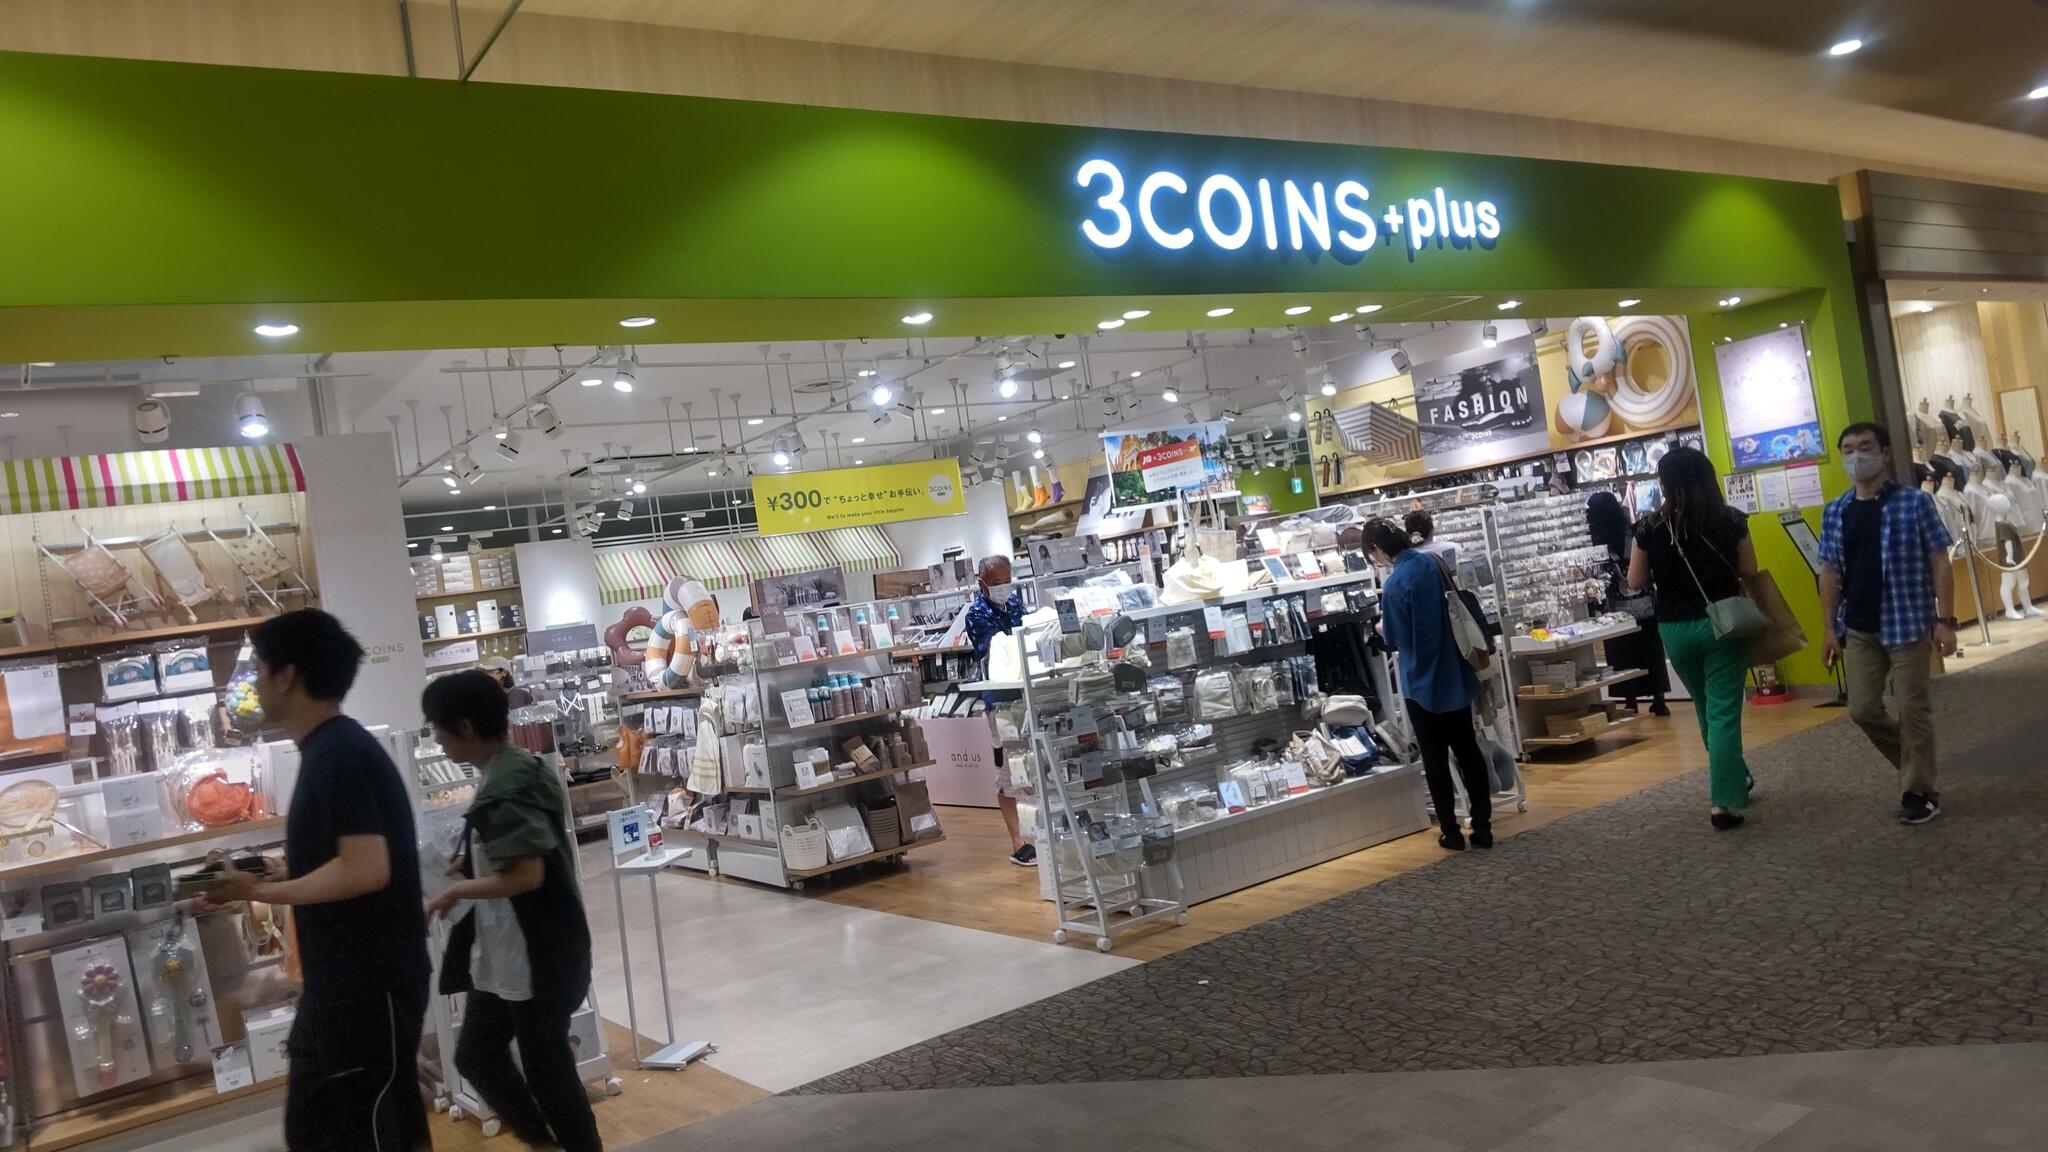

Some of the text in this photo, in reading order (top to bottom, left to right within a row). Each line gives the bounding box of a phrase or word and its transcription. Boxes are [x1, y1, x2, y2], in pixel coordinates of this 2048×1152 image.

[1430, 386, 1528, 424] FASHION
[1157, 448, 1184, 461] 3COINS
[951, 749, 982, 762] and us
